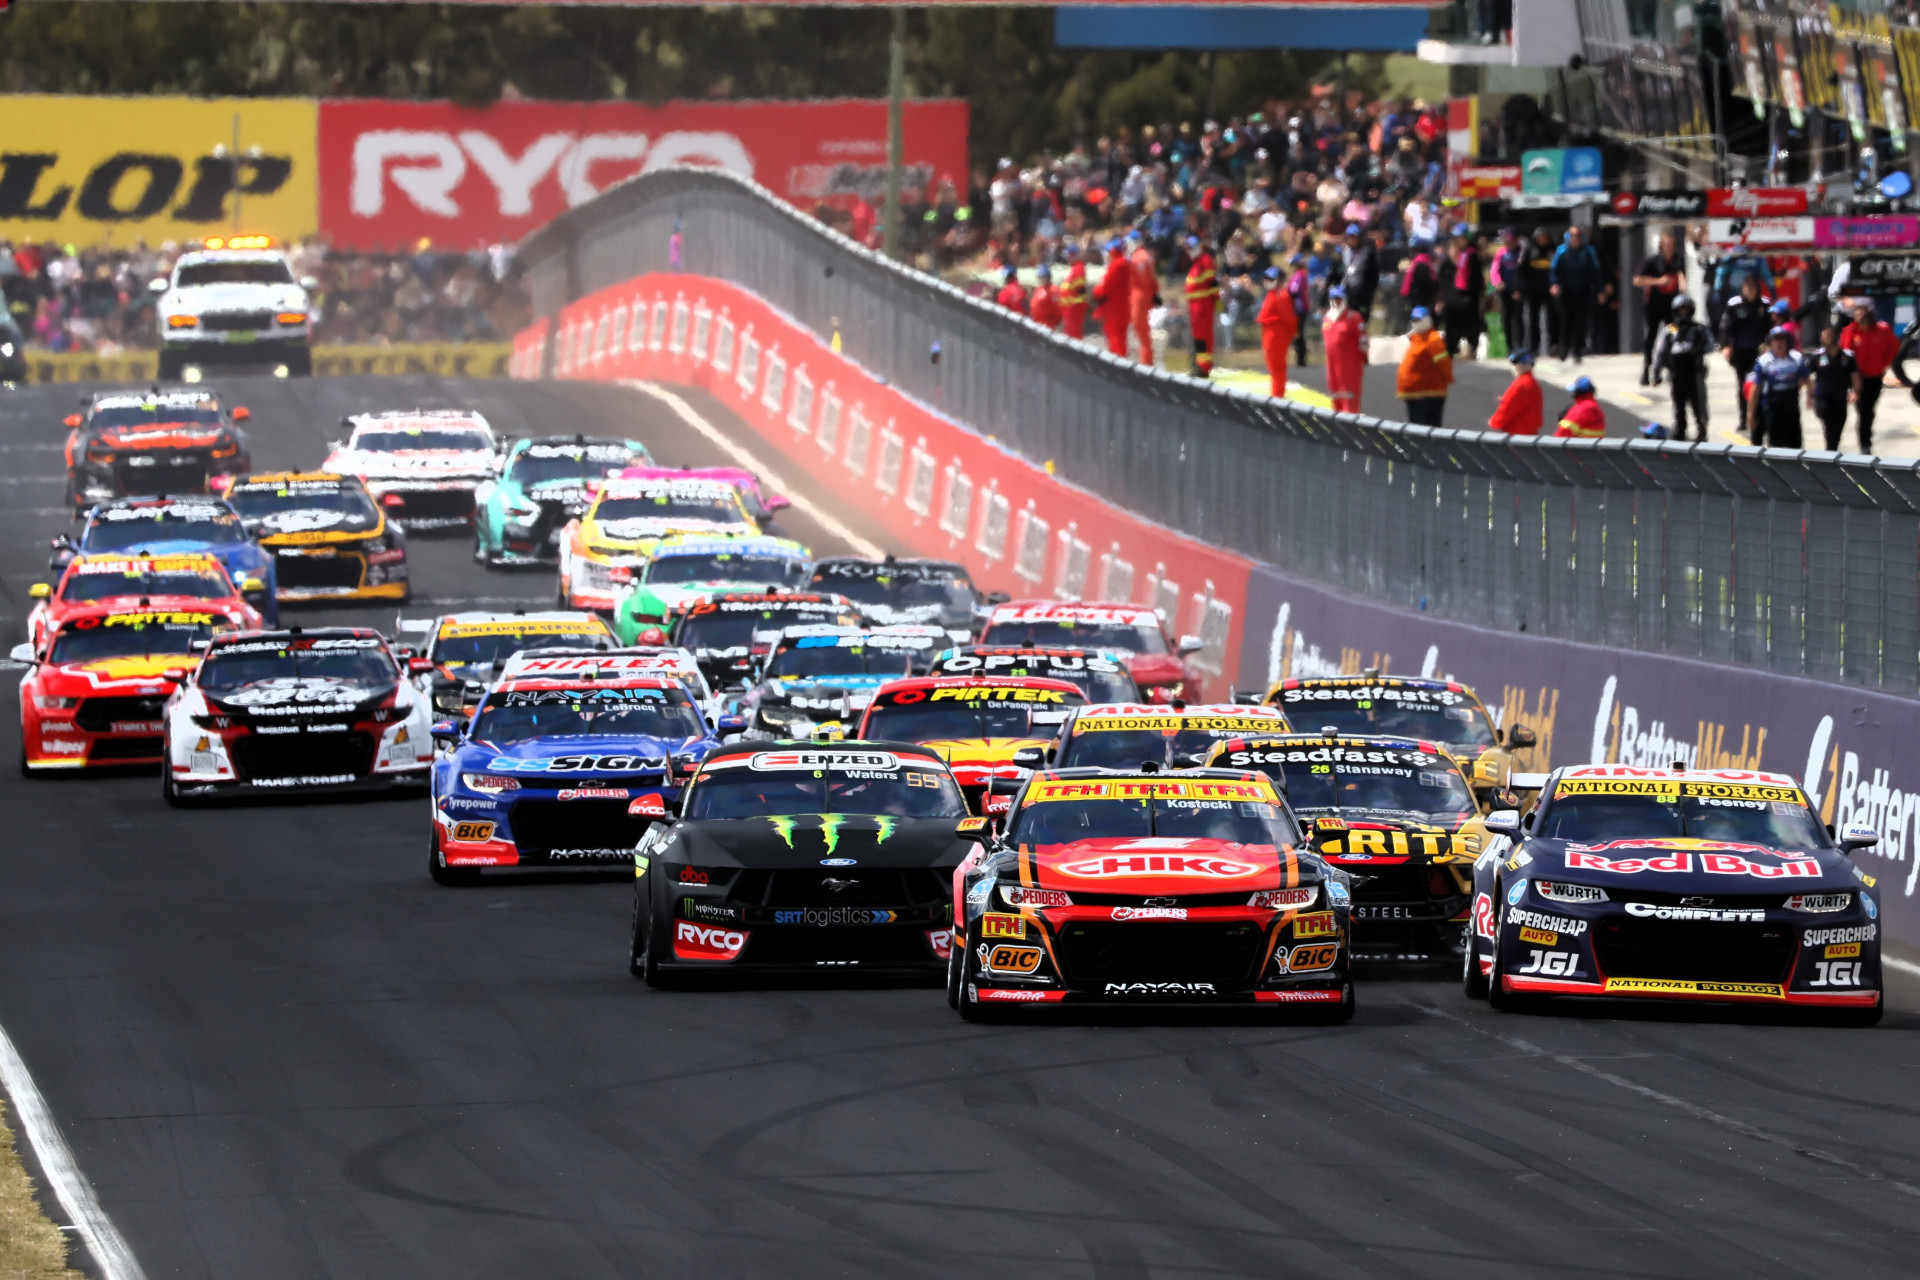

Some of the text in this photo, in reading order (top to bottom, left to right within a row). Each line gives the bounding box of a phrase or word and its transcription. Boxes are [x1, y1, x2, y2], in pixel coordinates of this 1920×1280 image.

[104, 612, 214, 627] PIRTEK
[522, 659, 681, 671] HIFLEX
[943, 652, 1119, 673] OPTUS
[1010, 668, 1027, 676] 25
[930, 687, 1067, 703] PIRTEK
[1284, 687, 1430, 703] Steadfast
[572, 704, 581, 712] 9
[967, 701, 980, 709] 11
[1086, 704, 1276, 717] AMOL
[1357, 701, 1440, 712] 19 Payne
[1079, 718, 1280, 731] NATIONAL STORAGE
[1251, 738, 1366, 749] PENRITE
[802, 755, 884, 765] ENZED
[1230, 748, 1400, 766] Steadfast
[813, 770, 898, 780] 6 Waters
[1310, 765, 1413, 778] 26 Stanaway
[1569, 766, 1790, 785] AMOL
[481, 776, 518, 790] PEDDERS
[906, 772, 940, 789] 55
[575, 788, 629, 799] PEDDERS
[1043, 784, 1259, 798] TFH TFH TFH
[1559, 781, 1794, 802] NATIONAL STORAGE
[631, 806, 666, 815] RYCO
[1139, 799, 1232, 809] 1 Kostecki
[1656, 795, 1767, 811] 88 Feeney
[962, 819, 982, 828] TFH
[1319, 819, 1343, 828] TFH
[1346, 830, 1482, 859] RITE
[1065, 856, 1254, 876] CHIKO
[1566, 852, 1822, 878] Red Bull
[680, 865, 709, 883] dba
[1022, 889, 1067, 906] PEDDERS
[1268, 889, 1310, 906] PEDDERS
[695, 904, 735, 917] MONSTER
[1133, 907, 1188, 919] PEDDERS
[1625, 902, 1766, 922] COMPLETE
[984, 915, 1020, 934] TFH
[1296, 914, 1332, 933] TFH
[1507, 906, 1588, 936] SUPERCHEAP
[678, 922, 744, 950] RYCO
[1523, 930, 1554, 942] AUTO
[1803, 923, 1877, 947] SUPERCHEAP
[1828, 945, 1857, 955] AUTO
[1519, 949, 1580, 977] JGI
[1809, 961, 1862, 986] JGI
[1609, 979, 1778, 994] NATIONAL STORAGE
